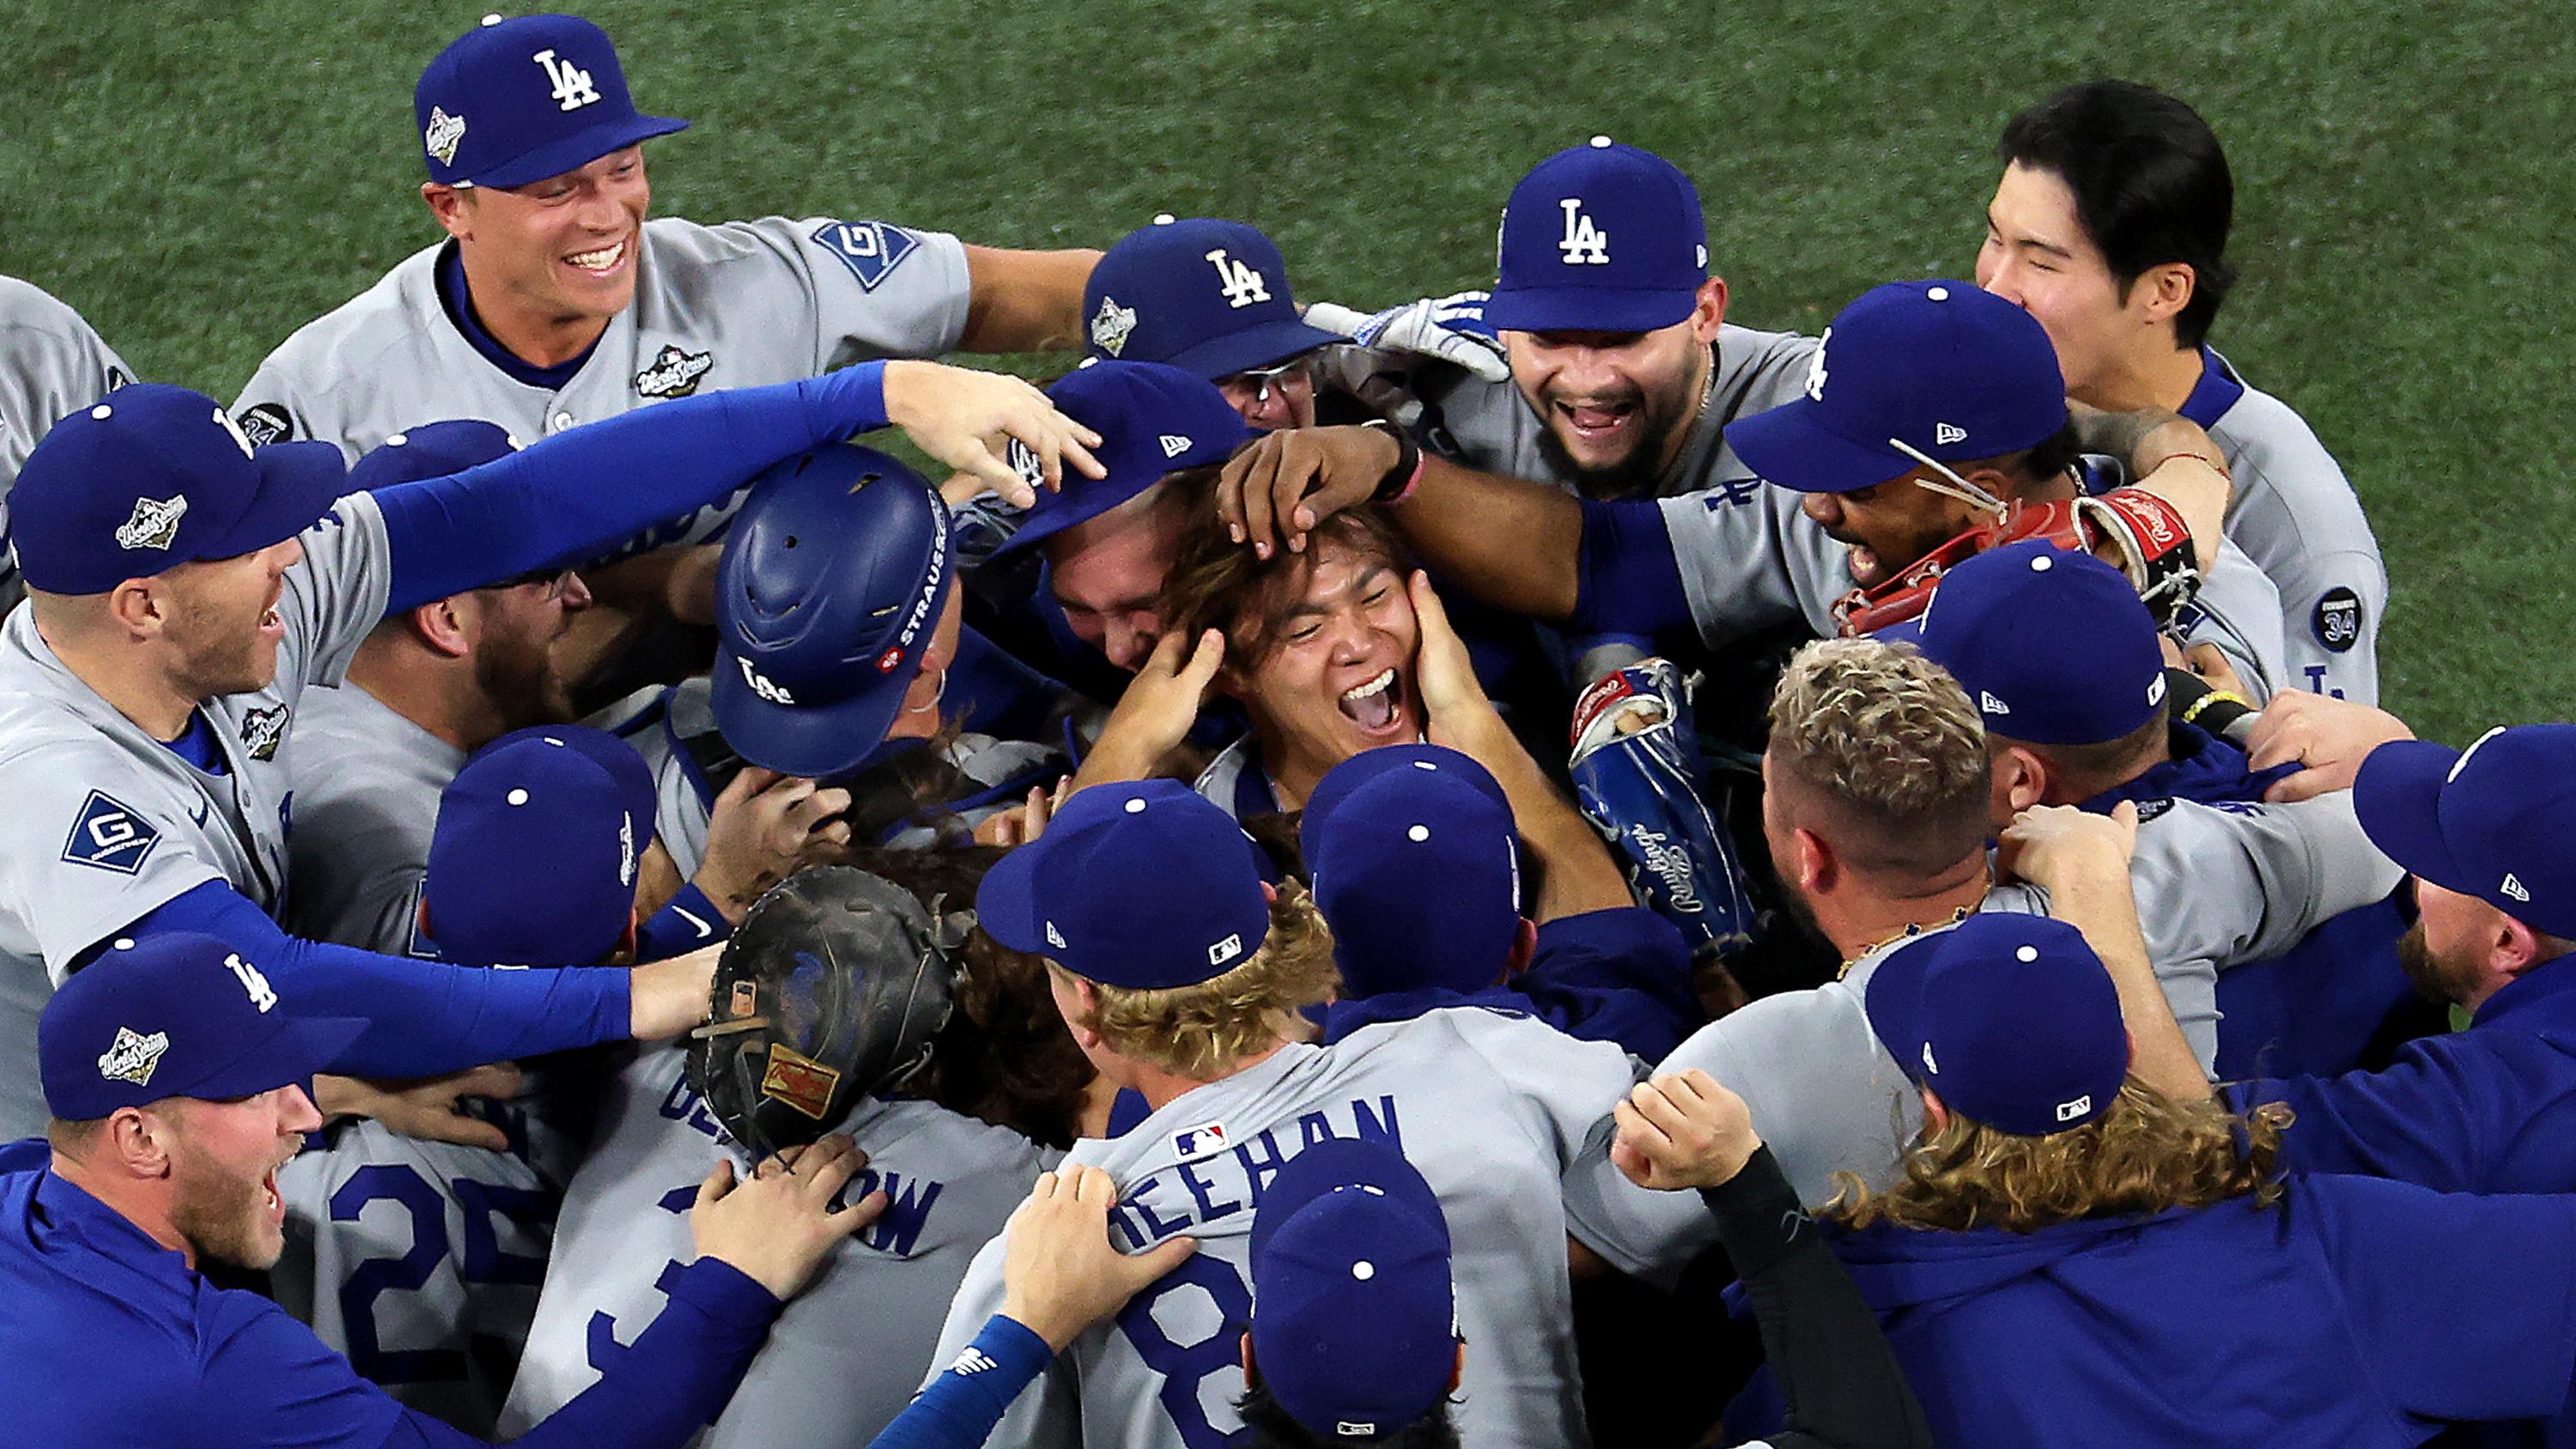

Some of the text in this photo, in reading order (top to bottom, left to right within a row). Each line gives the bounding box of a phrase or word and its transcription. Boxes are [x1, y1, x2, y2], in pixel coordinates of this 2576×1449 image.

[533, 49, 601, 111] LA
[1558, 198, 1610, 264] LA
[1205, 249, 1272, 308] LA
[900, 536, 946, 646] STRAUSS
[2324, 609, 2357, 642] 34
[737, 656, 795, 704] LA
[223, 953, 278, 1014] LA
